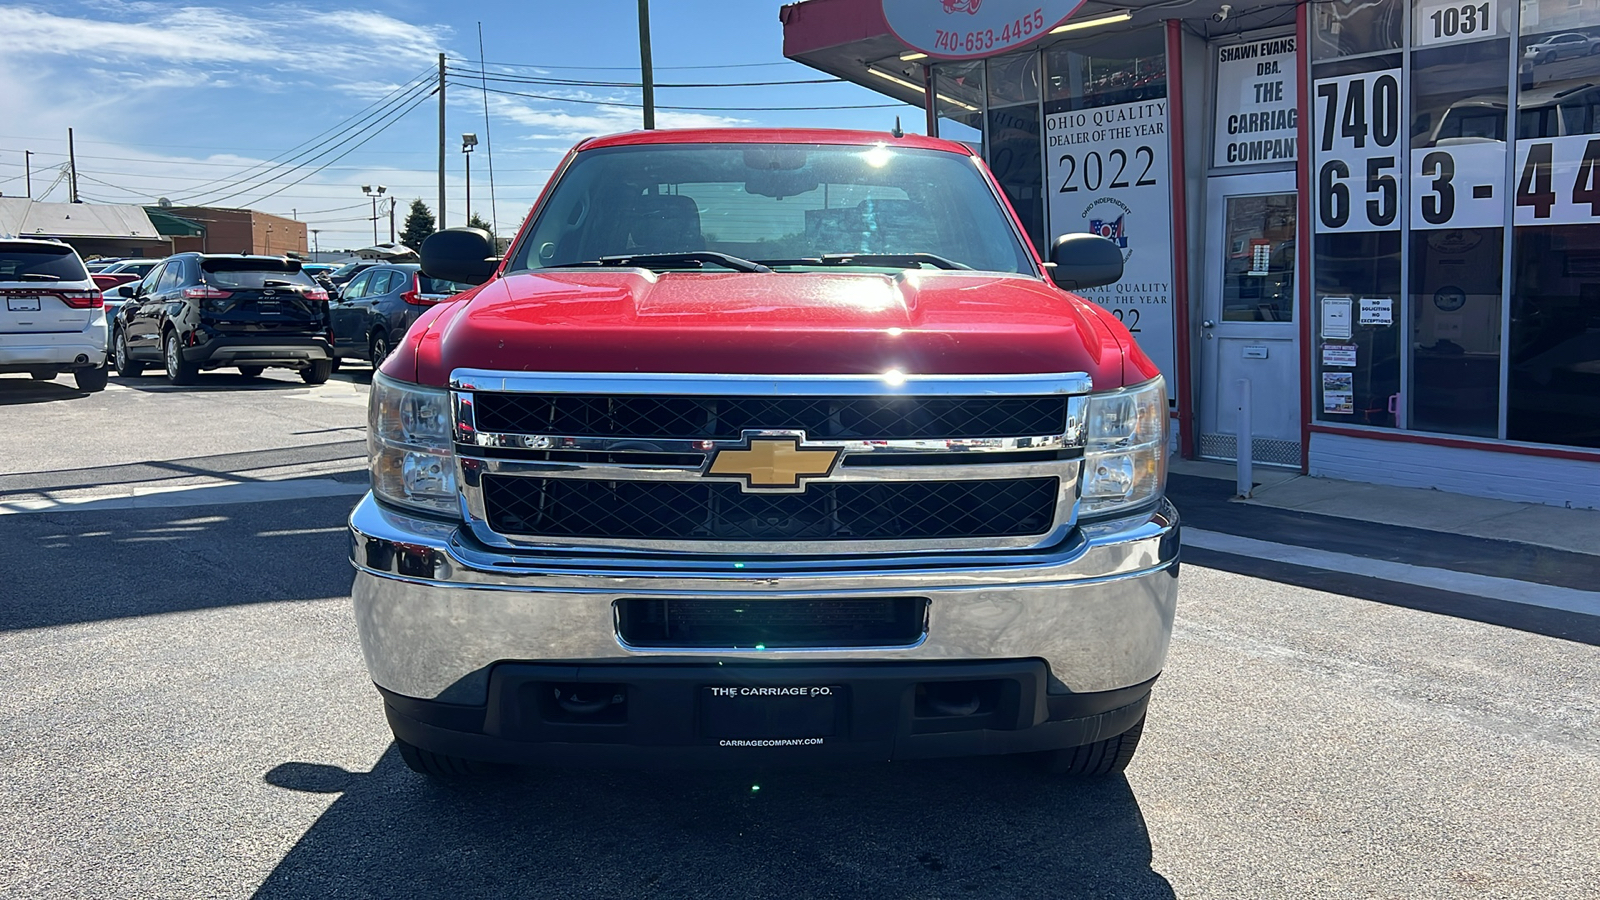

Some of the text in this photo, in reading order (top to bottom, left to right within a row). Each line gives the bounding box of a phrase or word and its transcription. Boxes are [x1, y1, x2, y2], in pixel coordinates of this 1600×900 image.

[934, 8, 1044, 51] 740-653-4455
[1430, 3, 1490, 38] 1031
[1220, 44, 1258, 62] SHAWN
[1256, 61, 1281, 76] DBA.
[1254, 81, 1283, 103] THE
[1047, 113, 1086, 131] OHIO
[1093, 102, 1165, 126] QUALITY
[1227, 108, 1298, 135] CARRIAG
[1317, 75, 1399, 151] 740
[1049, 122, 1164, 147] DEALER OF THE YEAR
[1227, 138, 1298, 163] COMPAN
[1059, 145, 1156, 193] 2022
[1081, 196, 1132, 219] OHIO INDEPENDENT
[1098, 296, 1110, 304] OF
[1115, 296, 1135, 304] THE
[1140, 296, 1168, 304] YEAR
[1116, 283, 1169, 294] QUALITY
[1112, 308, 1141, 333] 22
[711, 687, 833, 696] THE CARRIAGE CO.
[719, 738, 824, 747] CARRIAGECOMPANY.COM
